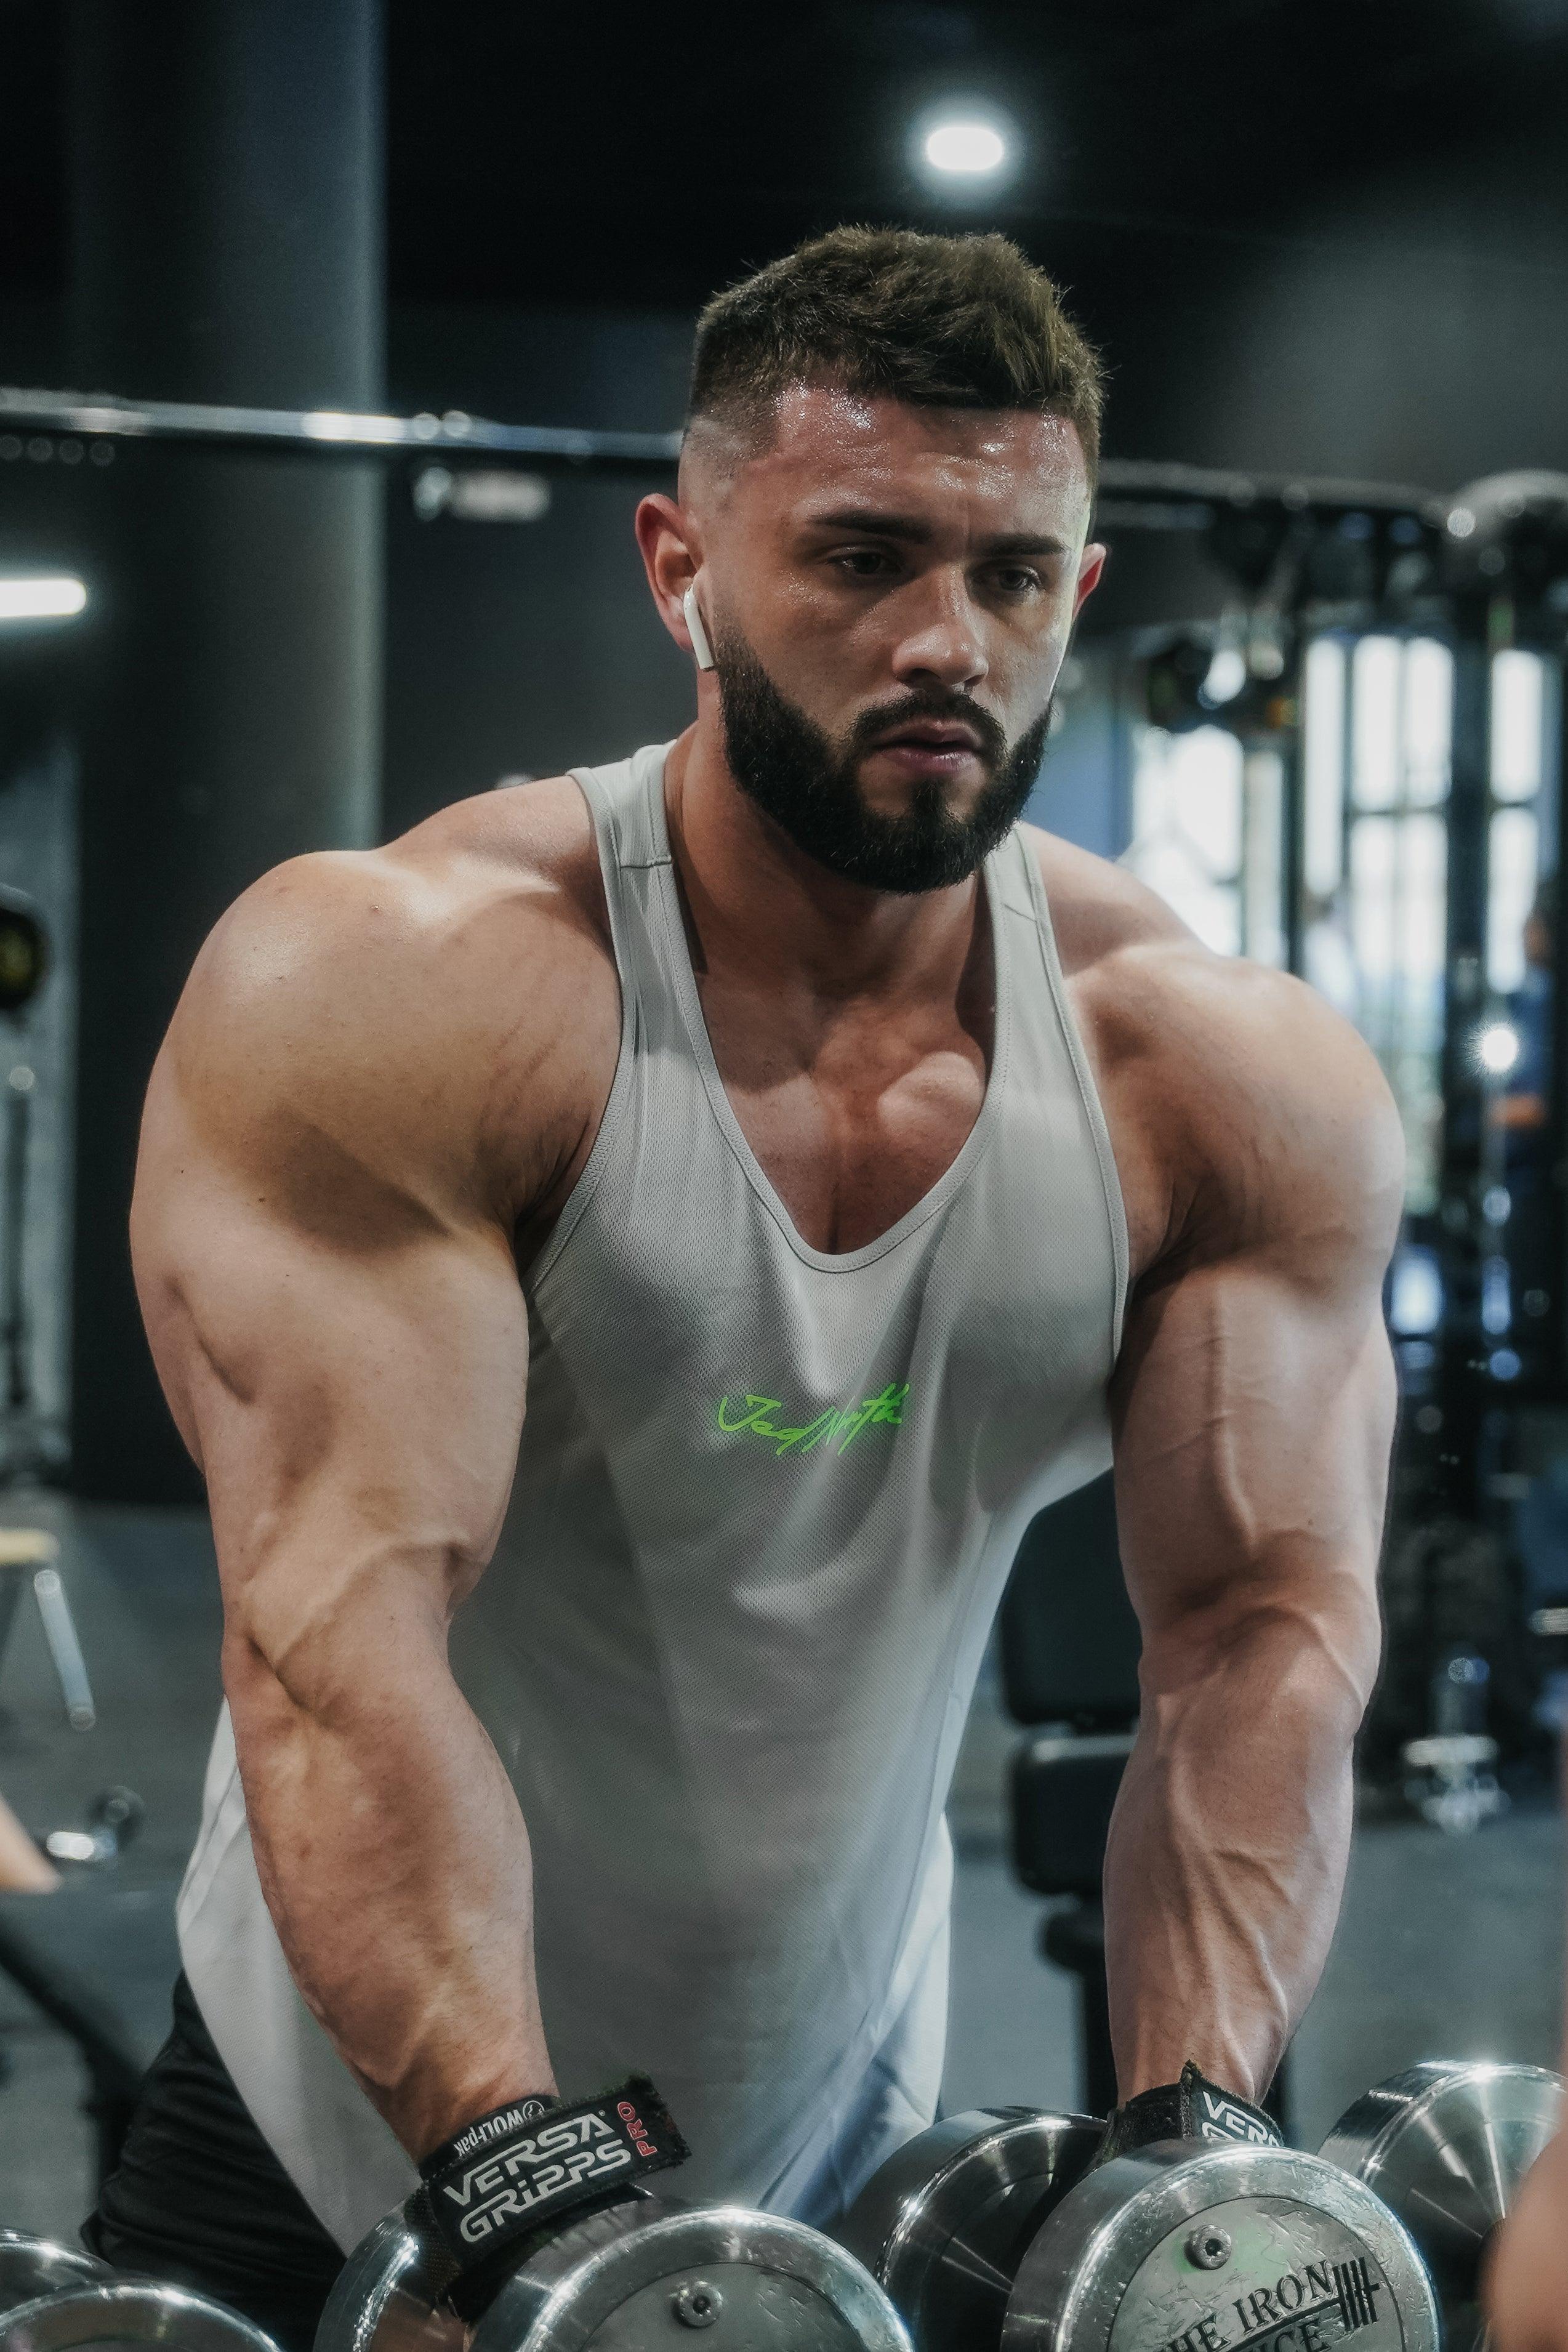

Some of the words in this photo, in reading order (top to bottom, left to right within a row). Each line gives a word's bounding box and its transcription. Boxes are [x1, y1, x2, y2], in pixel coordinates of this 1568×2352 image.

[617, 2101, 658, 2157] PRO
[1167, 2313, 1231, 2352] HE
[1232, 2260, 1333, 2335] IRON
